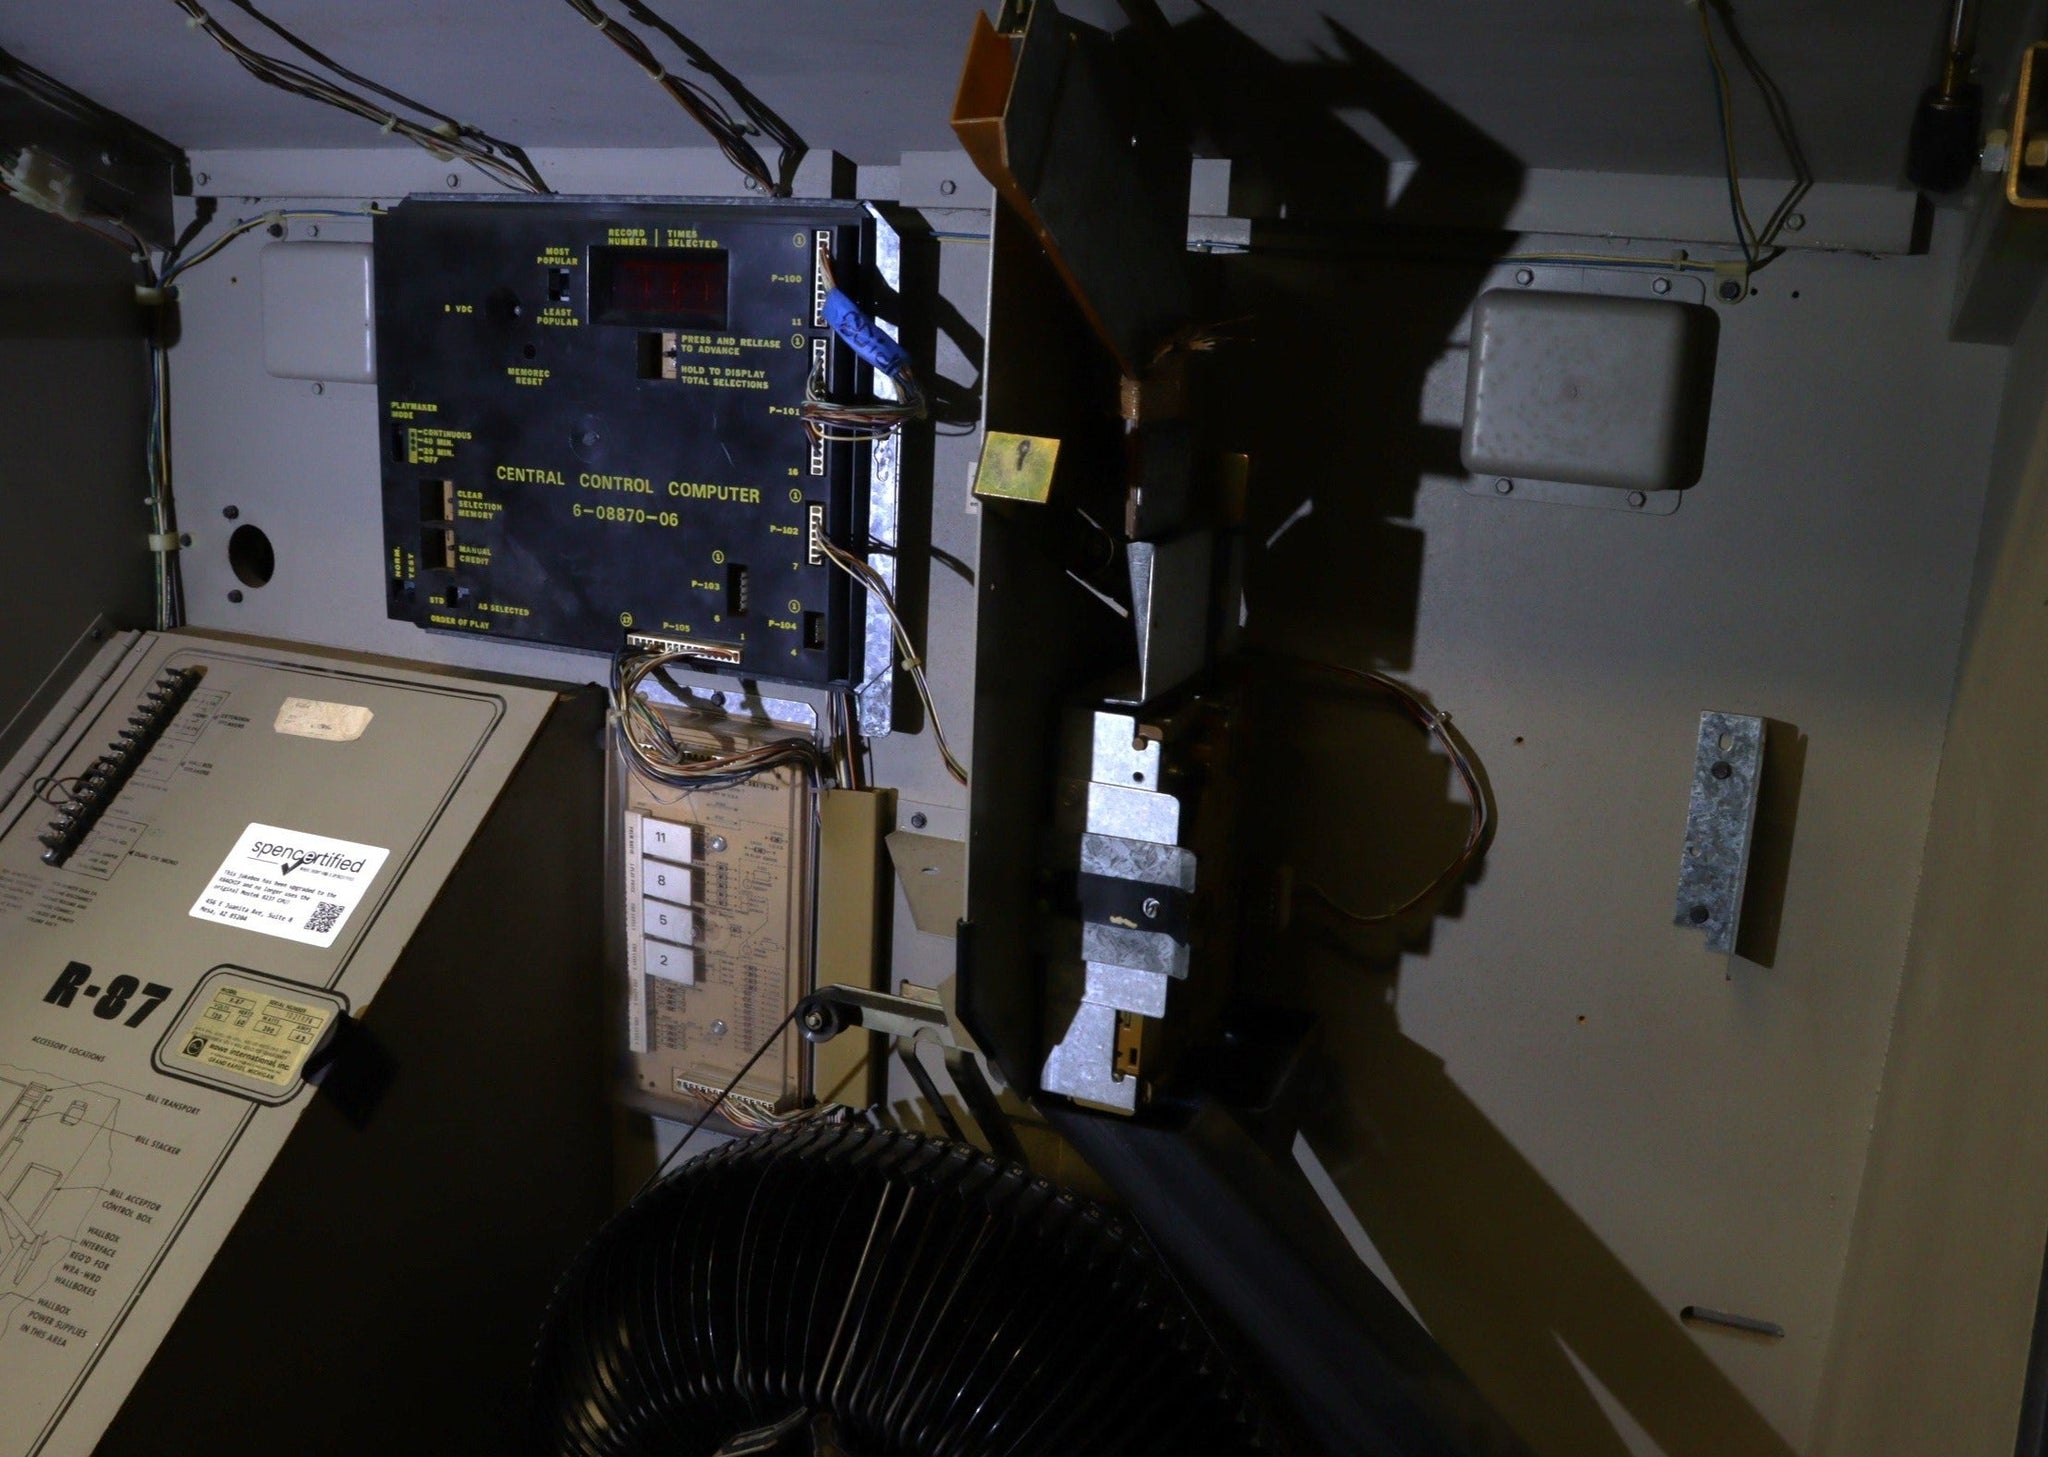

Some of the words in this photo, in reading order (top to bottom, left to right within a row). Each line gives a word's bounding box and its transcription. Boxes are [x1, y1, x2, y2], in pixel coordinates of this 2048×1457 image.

[608, 228, 646, 238] RECORD
[667, 230, 698, 238] TIMES
[608, 237, 648, 246] NUMBER
[667, 238, 719, 248] SELECTED
[546, 247, 570, 256] MOST
[537, 256, 578, 266] POPULAR
[771, 274, 802, 284] P-100
[456, 305, 473, 314] VDC
[543, 308, 572, 316] LEAST
[536, 316, 579, 326] POPULAR
[682, 335, 712, 345] PRESS
[717, 337, 736, 346] AND
[740, 338, 782, 348] RELEASE
[682, 344, 694, 353] TO
[698, 346, 740, 356] ADVANCE
[682, 366, 705, 375] HOLD
[709, 367, 722, 376] TO
[725, 368, 766, 379] DISPLAY
[516, 376, 544, 386] RESET
[682, 376, 710, 386] TOTAL
[713, 378, 769, 390] SELECTIONS
[391, 402, 438, 412] PLAYMAKER
[769, 406, 800, 416] P-101
[391, 411, 414, 420] MODE
[496, 466, 565, 486] CENTRAL
[579, 473, 654, 494] CONTROL
[668, 481, 760, 504] COMPUTER
[457, 490, 483, 500] CLEAR
[458, 500, 502, 511] SELECTION
[458, 510, 494, 520] MEMORY
[573, 504, 679, 528] 6-08870-06
[770, 525, 799, 535] P-102
[458, 546, 492, 556] MANUAL
[459, 555, 490, 566] CREDIT
[792, 562, 799, 570] 7
[691, 580, 720, 591] P-103
[429, 596, 445, 605] STD
[478, 603, 489, 611] AS
[490, 604, 530, 616] SELECTED
[430, 615, 457, 626] ORDER
[458, 618, 468, 626] OF
[470, 620, 490, 630] PLAY
[663, 622, 691, 632] P-105
[768, 620, 797, 630] P-104
[655, 832, 666, 844] 11
[251, 839, 366, 874] spencertified
[658, 874, 666, 886] 8
[214, 884, 239, 894] original
[659, 914, 668, 926] 5
[660, 954, 668, 966] 2
[43, 960, 174, 1028] R-87
[32, 1036, 68, 1050] ACCESSORY
[68, 1047, 106, 1062] LOCATIONS
[146, 1094, 160, 1103] BILL
[161, 1097, 200, 1116] TRANSPORT
[136, 1134, 150, 1146] BILL
[152, 1140, 182, 1156] STACKER
[110, 1188, 124, 1200] BILL
[125, 1193, 162, 1212] ACCEPTOR
[102, 1202, 134, 1218] CONTROL
[136, 1212, 153, 1224] BOX
[88, 1226, 120, 1244] WALLBOX
[80, 1239, 117, 1258] INTERFACE
[94, 1259, 110, 1272] FOR
[54, 1276, 97, 1298] WALLBOXES
[38, 1298, 70, 1316] WALLBOX
[28, 1310, 54, 1326] POWER
[54, 1320, 88, 1338] SUPPLIES
[20, 1323, 29, 1332] IN
[30, 1327, 46, 1339] THIS
[46, 1334, 68, 1348] AREA
